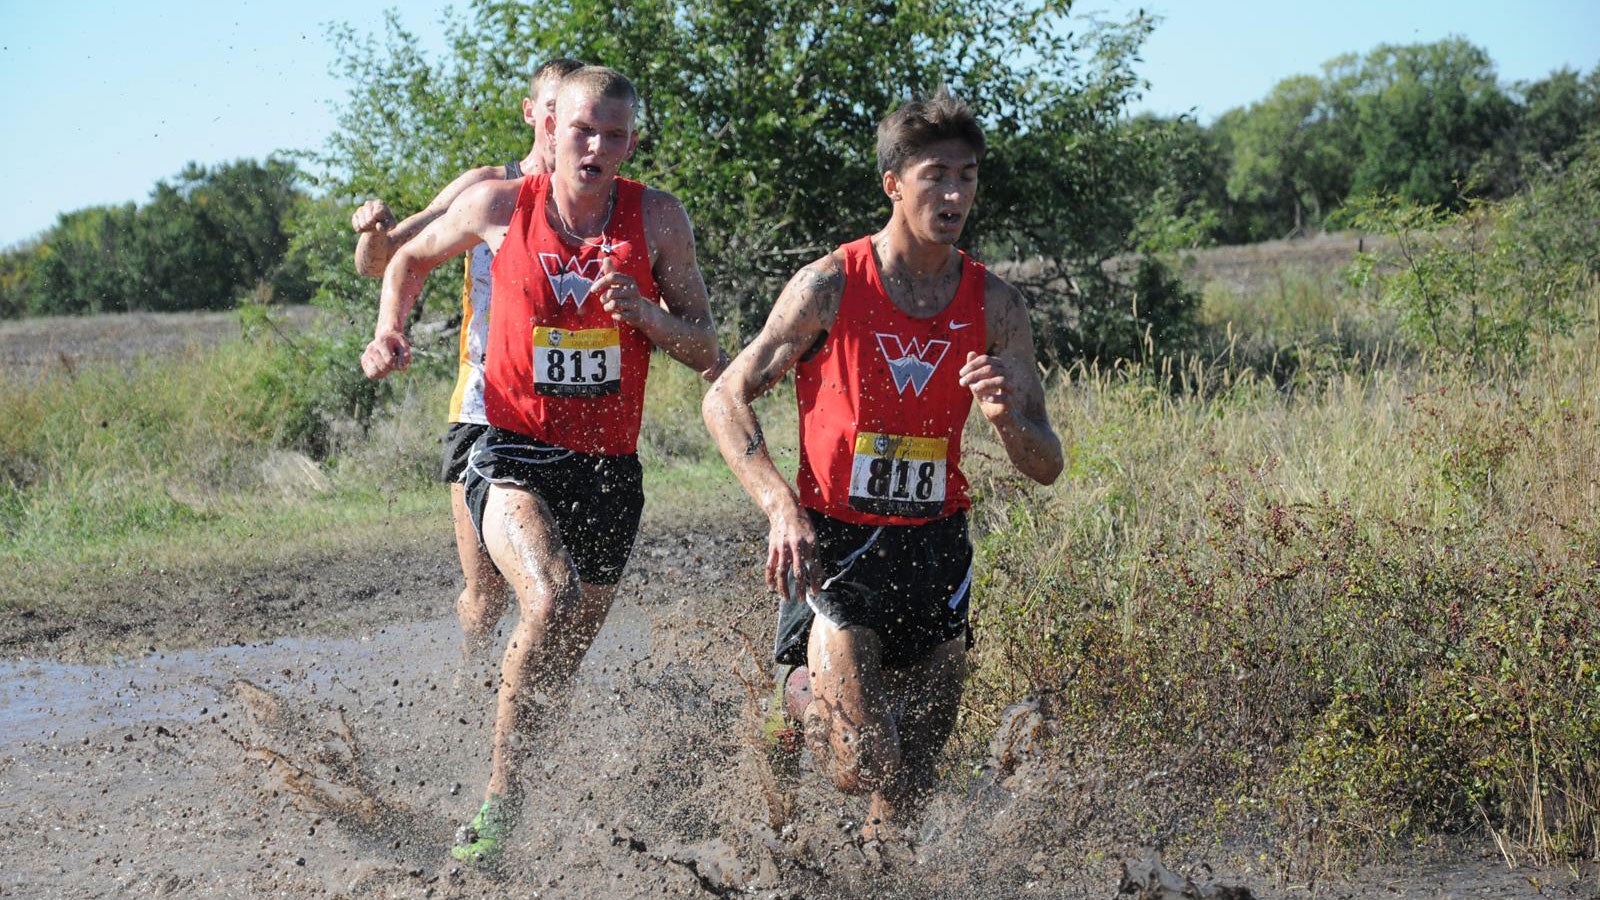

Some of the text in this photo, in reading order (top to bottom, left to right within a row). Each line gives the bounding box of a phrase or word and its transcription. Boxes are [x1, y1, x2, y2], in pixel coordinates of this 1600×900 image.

[538, 252, 605, 308] W
[547, 349, 607, 382] 813
[875, 332, 952, 397] W
[867, 457, 935, 500] 818
